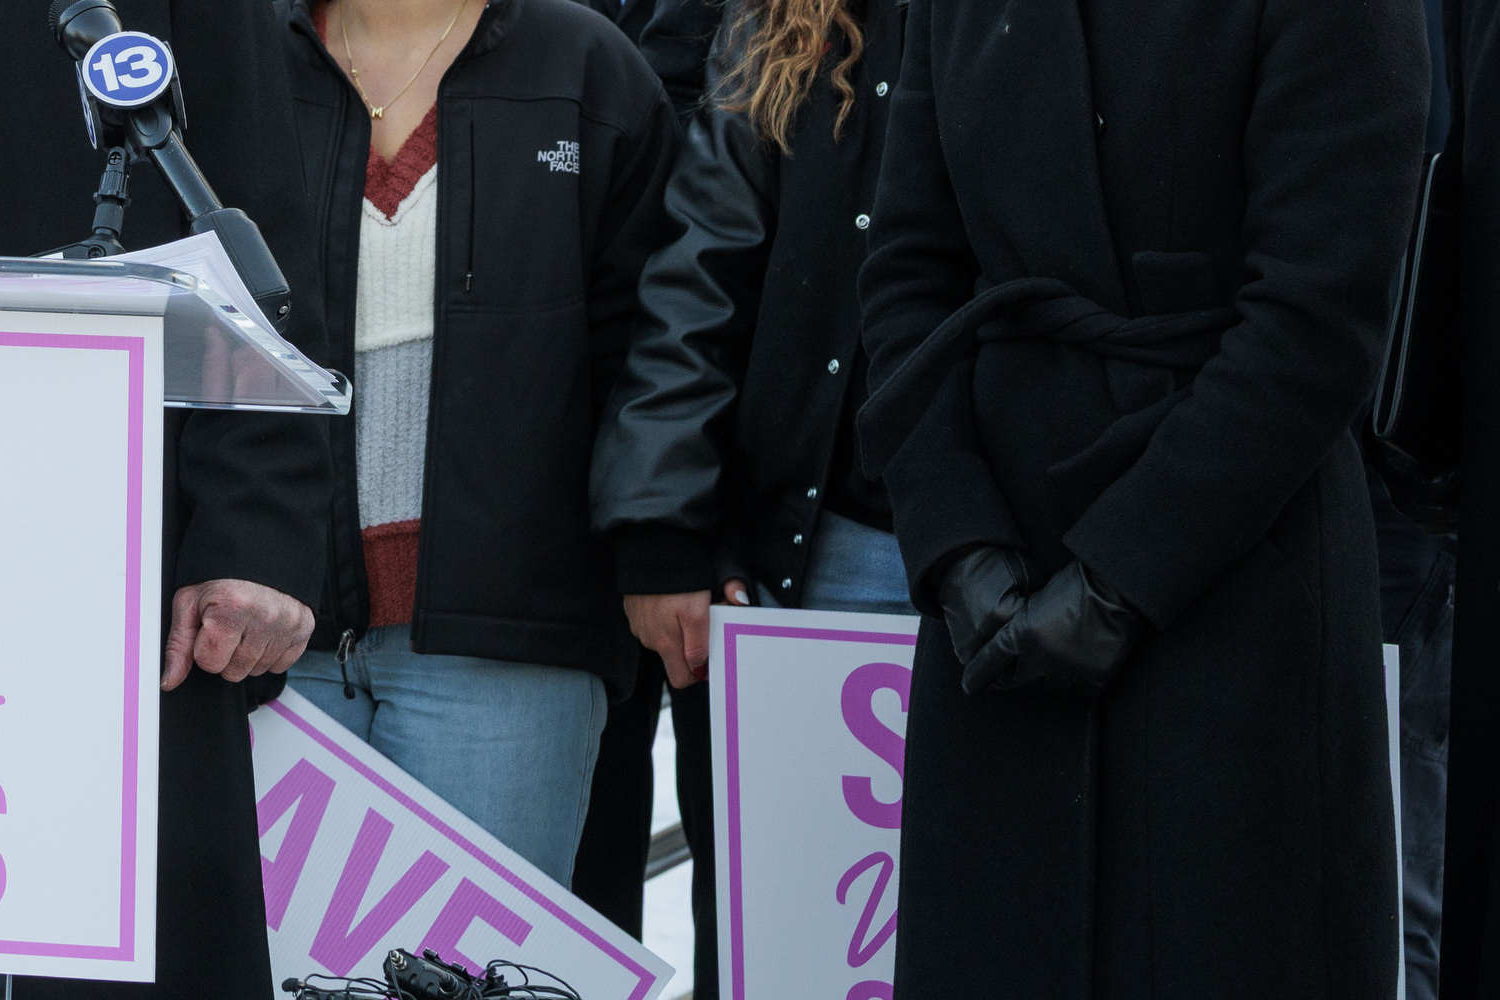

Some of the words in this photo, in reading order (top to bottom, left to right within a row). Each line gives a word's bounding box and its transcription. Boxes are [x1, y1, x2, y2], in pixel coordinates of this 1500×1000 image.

[92, 45, 163, 92] 13
[557, 141, 579, 153] THE
[537, 151, 579, 162] NORTH
[550, 161, 579, 174] FACE
[250, 725, 533, 982] AVE
